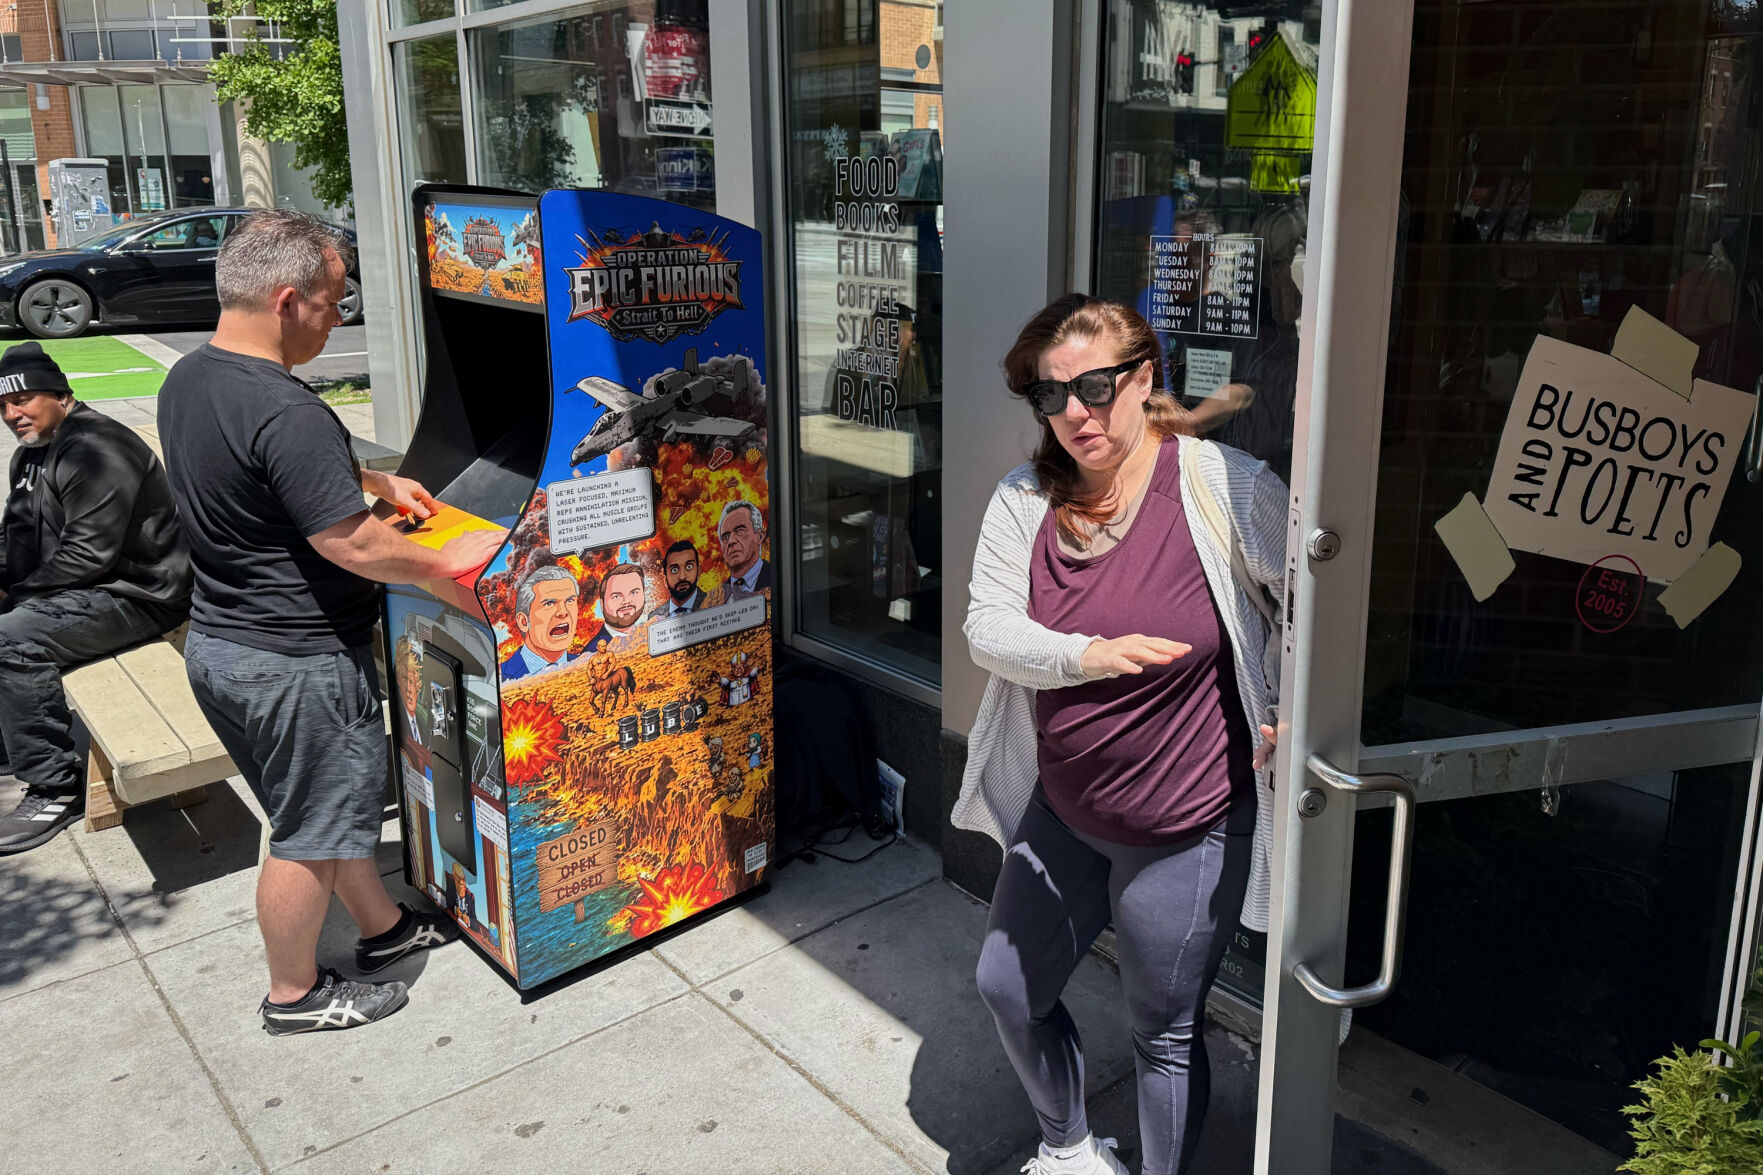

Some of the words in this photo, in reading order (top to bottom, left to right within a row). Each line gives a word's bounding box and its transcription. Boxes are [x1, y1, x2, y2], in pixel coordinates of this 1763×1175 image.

[835, 156, 898, 197] FOOD
[835, 202, 899, 234] BOOKS
[1155, 242, 1189, 252] MONDAY
[1192, 233, 1215, 242] HOURS
[617, 249, 699, 267] OPERATION
[837, 239, 899, 280] FILM
[1234, 257, 1254, 267] 10PM
[1154, 269, 1200, 279] WEDNESDAY
[1234, 271, 1254, 281] 10PM
[1154, 280, 1193, 292] THURSDAY
[1233, 283, 1253, 293] 10PM
[571, 268, 636, 316] EPIC
[640, 263, 741, 304] FURIOUS
[837, 282, 899, 314] COFFEE
[1153, 293, 1180, 303] FRIDAY
[1207, 295, 1224, 306] 8AM
[1232, 296, 1250, 307] 11PM
[622, 309, 658, 324] Strait
[661, 307, 674, 321] To
[676, 305, 698, 320] Hell
[1152, 305, 1192, 317] SATURDAY
[1206, 309, 1224, 318] 9AM
[1232, 310, 1249, 320] 11PM
[837, 313, 899, 352] STAGE
[1152, 318, 1182, 329] SUNDAY
[1206, 322, 1223, 332] 9AM
[1231, 324, 1251, 334] 10PM
[837, 349, 899, 378] INTERNET
[0, 373, 27, 396] RITY
[838, 374, 898, 431] BAR
[1527, 383, 1726, 476] BUSBOYS
[1507, 439, 1553, 512] AND
[556, 488, 574, 496] WE'RE
[578, 482, 612, 494] LAUNCHING
[579, 493, 608, 502] FOCUSED,
[610, 488, 636, 496] MAXIMUM
[1543, 445, 1711, 548] POETS
[556, 508, 572, 516] REPS
[576, 500, 619, 512] ANNIHILATION
[622, 495, 648, 504] MISSION,
[558, 515, 587, 526] CRUSHING
[603, 508, 624, 516] MUSCLE
[627, 504, 648, 512] GROUPS
[558, 527, 573, 535] WITH
[576, 521, 610, 532] SUSTAINED,
[612, 513, 648, 524] UNRELENTING
[558, 534, 590, 544] PRESSURE.
[1597, 569, 1628, 596] Est.
[1584, 590, 1627, 618] 2005
[670, 625, 686, 634] ENEMY
[688, 618, 710, 628] THOUGHT
[724, 610, 736, 618] SKIP
[657, 636, 670, 645] THAT
[686, 628, 700, 637] THEIR
[703, 624, 718, 632] FIRST
[548, 827, 606, 862] CLOSED
[561, 853, 596, 880] OPEN
[557, 872, 603, 900] CLOSED
